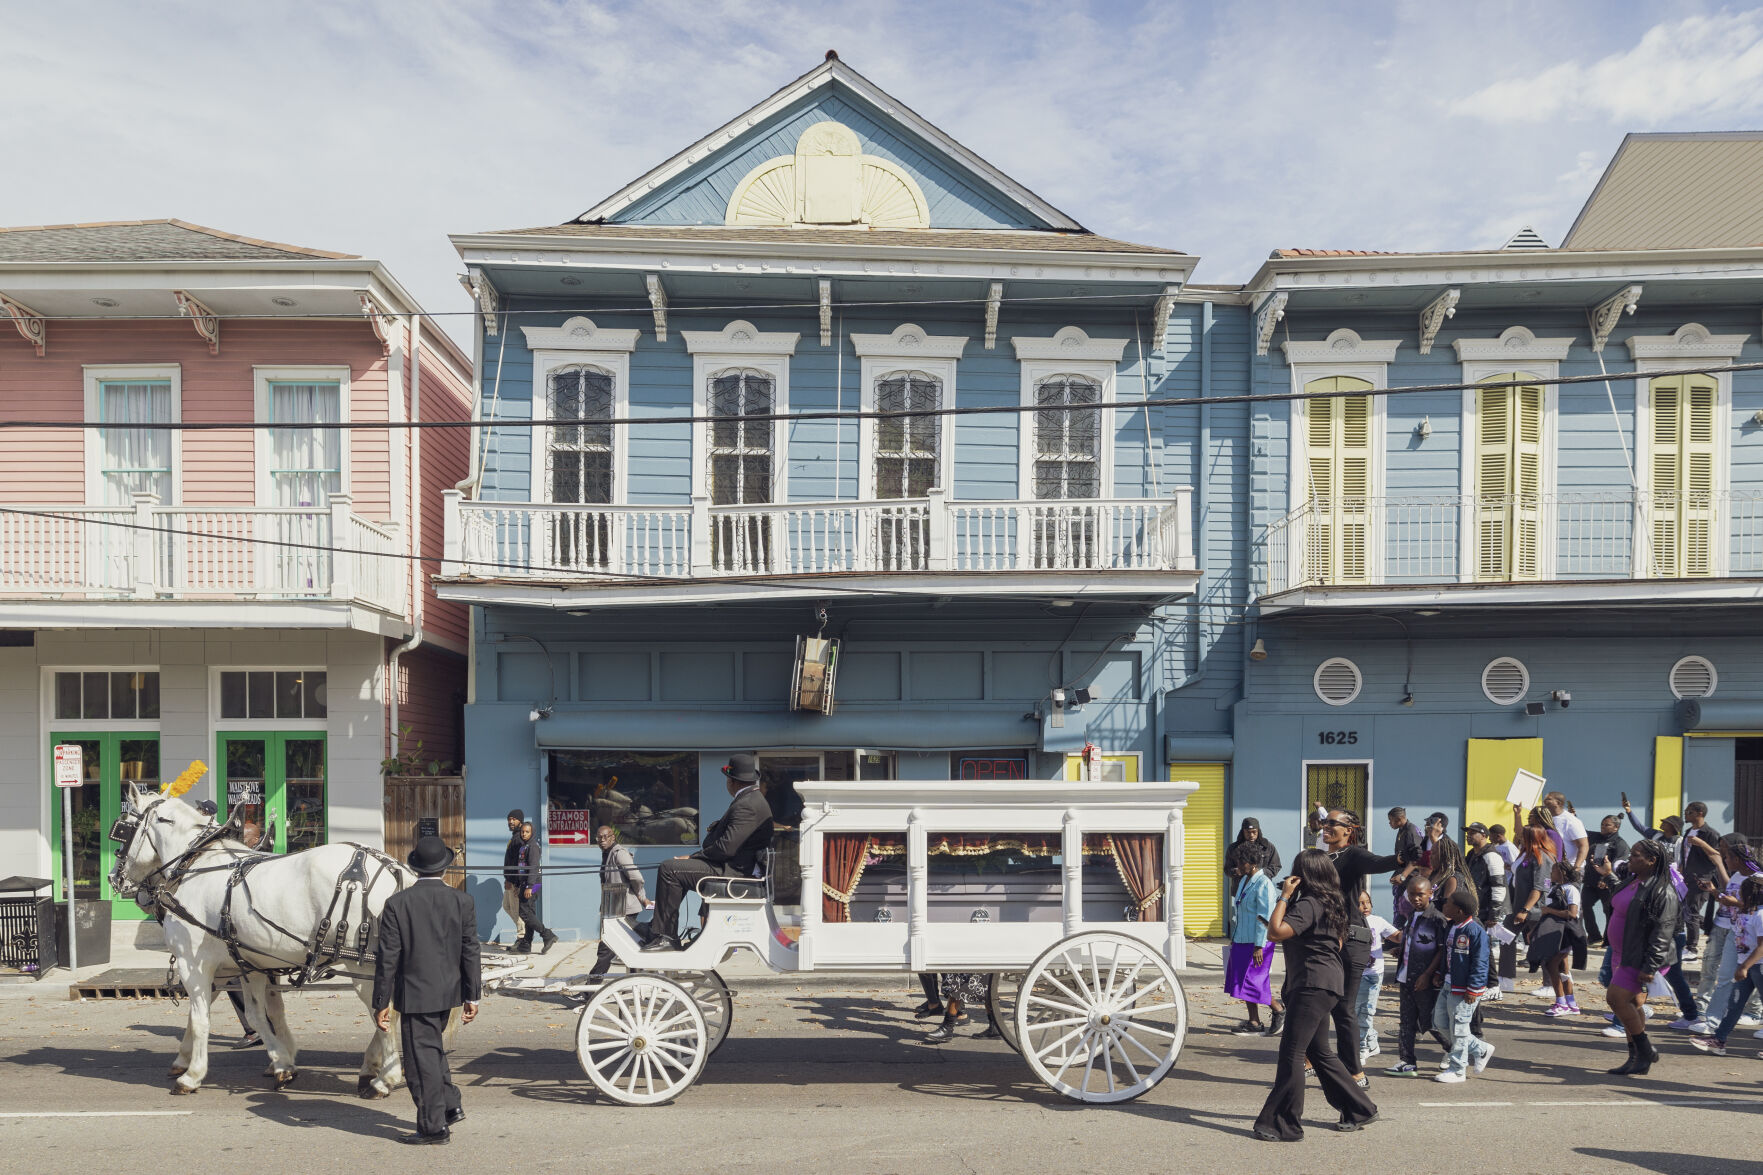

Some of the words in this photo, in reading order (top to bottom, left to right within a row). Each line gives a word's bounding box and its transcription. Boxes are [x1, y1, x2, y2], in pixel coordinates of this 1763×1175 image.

[1318, 731, 1358, 744] 1625
[962, 760, 1024, 781] OPEN
[549, 811, 585, 820] ESTAMOS
[548, 820, 588, 830] ONTRATANDO
